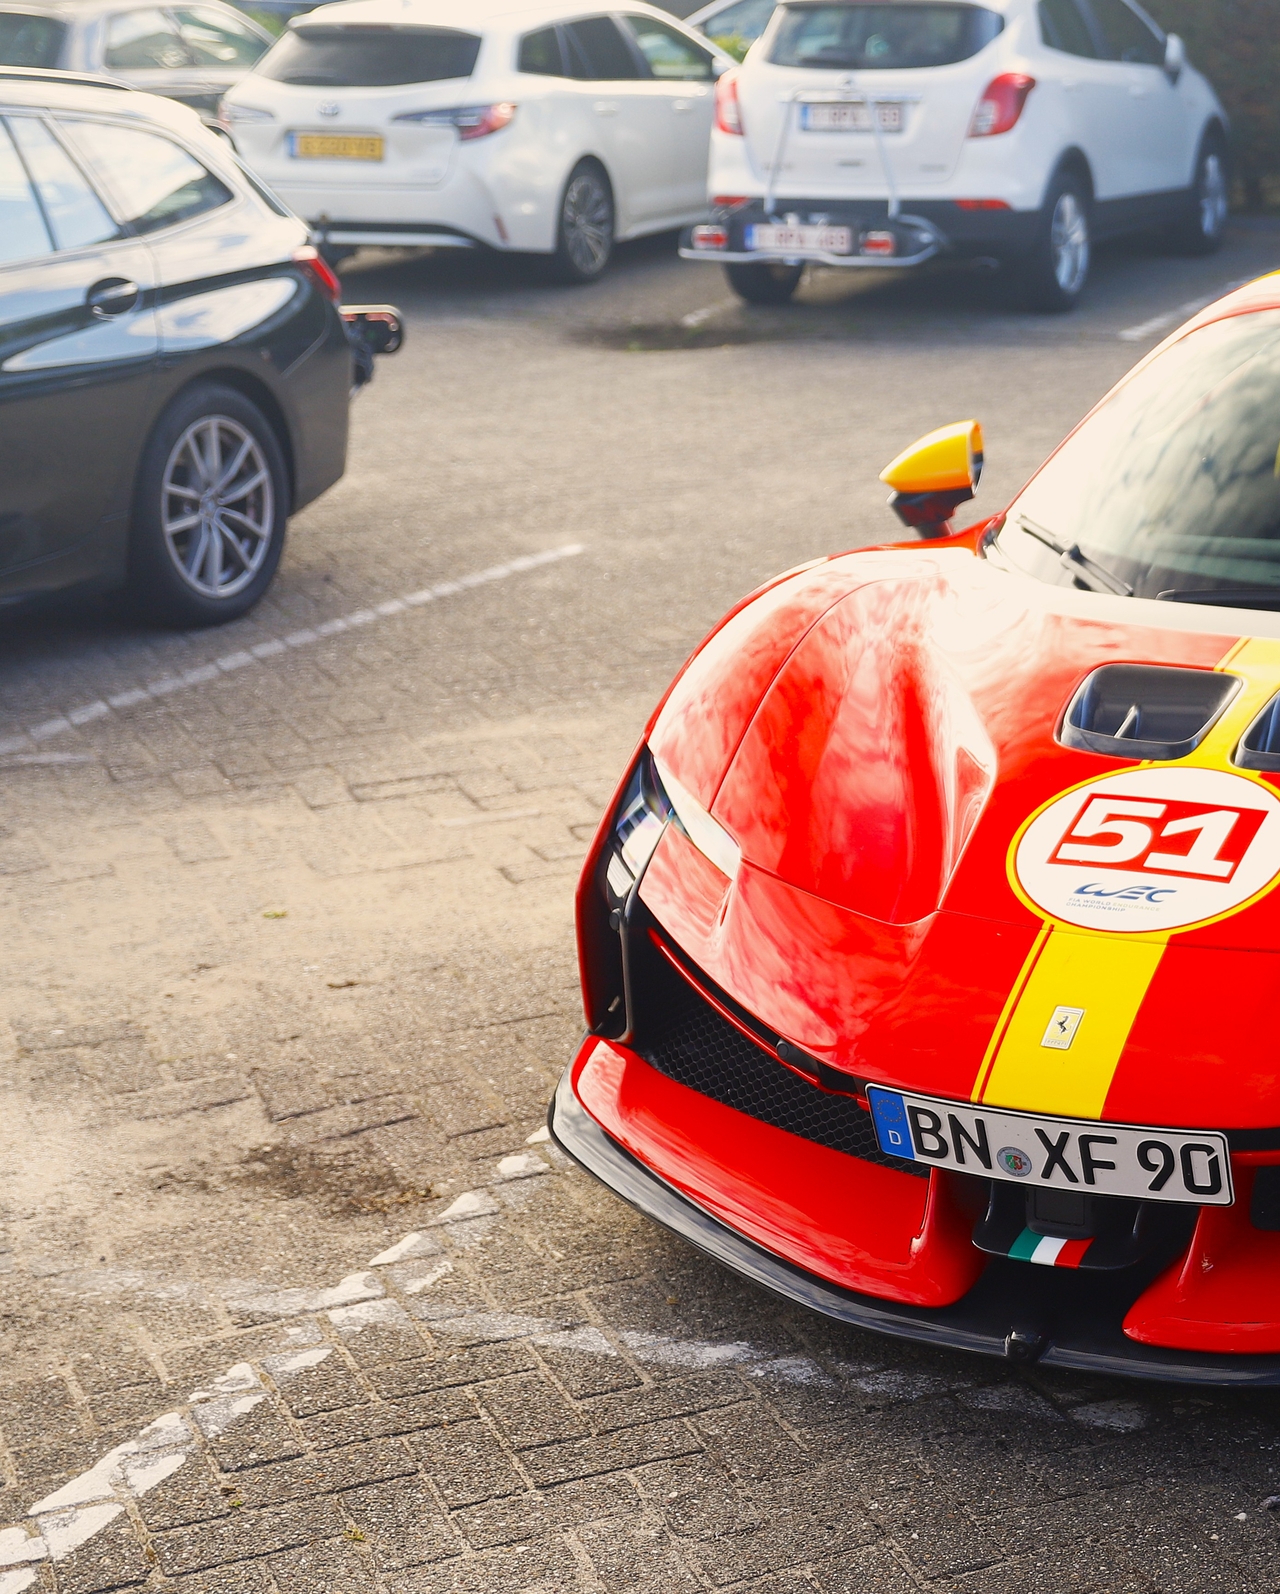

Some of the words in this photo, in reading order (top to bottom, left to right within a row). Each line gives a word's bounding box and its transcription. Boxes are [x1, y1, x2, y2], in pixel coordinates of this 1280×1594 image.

[1055, 798, 1240, 878] 51
[1073, 882, 1177, 903] WEC
[1066, 902, 1126, 912] CHAMPIONSHIP
[1112, 902, 1160, 912] ENDURANCE
[888, 1129, 902, 1145] D
[906, 1105, 992, 1170] BN
[1033, 1127, 1118, 1185] XF
[1136, 1140, 1222, 1195] 90
